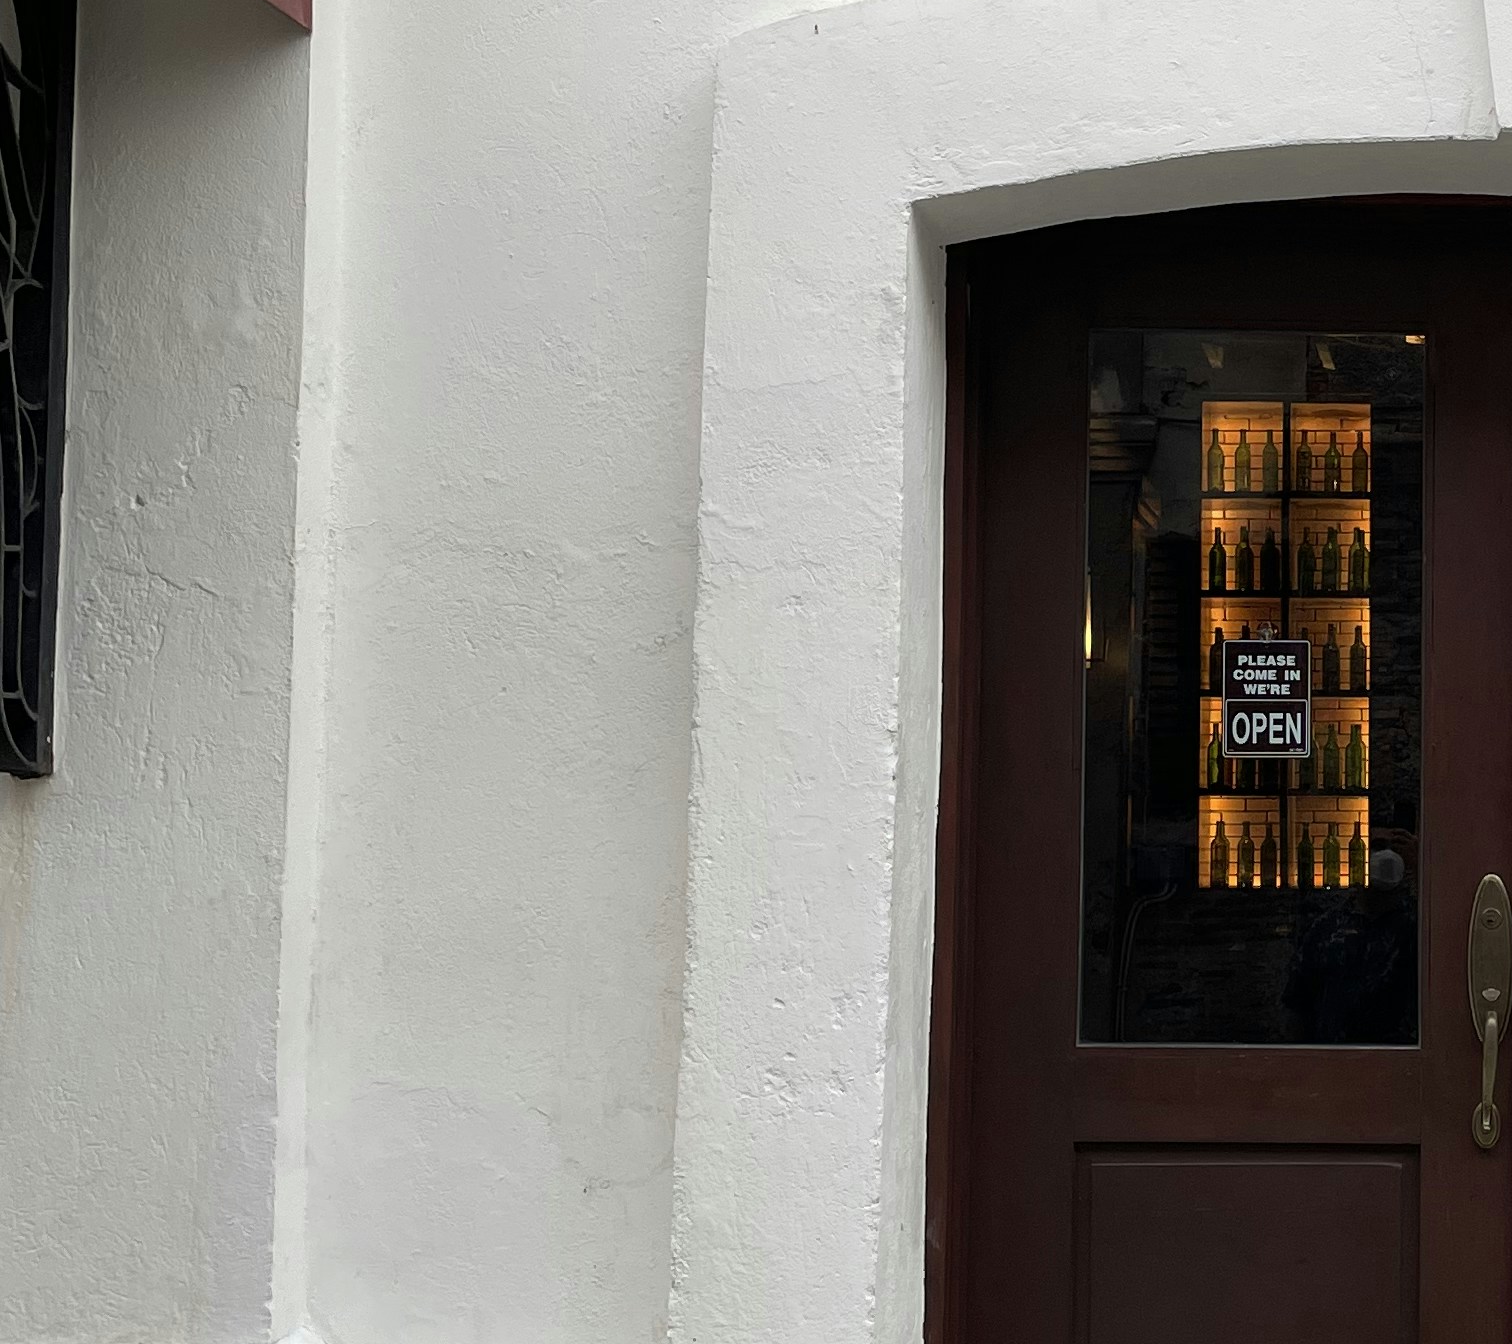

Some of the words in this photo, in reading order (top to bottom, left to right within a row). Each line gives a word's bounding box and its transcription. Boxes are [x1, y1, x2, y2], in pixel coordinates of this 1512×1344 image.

[1237, 655, 1296, 666] PLEASE
[1233, 669, 1277, 681] COME
[1284, 669, 1301, 681] IN
[1243, 684, 1291, 695] WE'RE
[1232, 712, 1302, 745] OPEN
